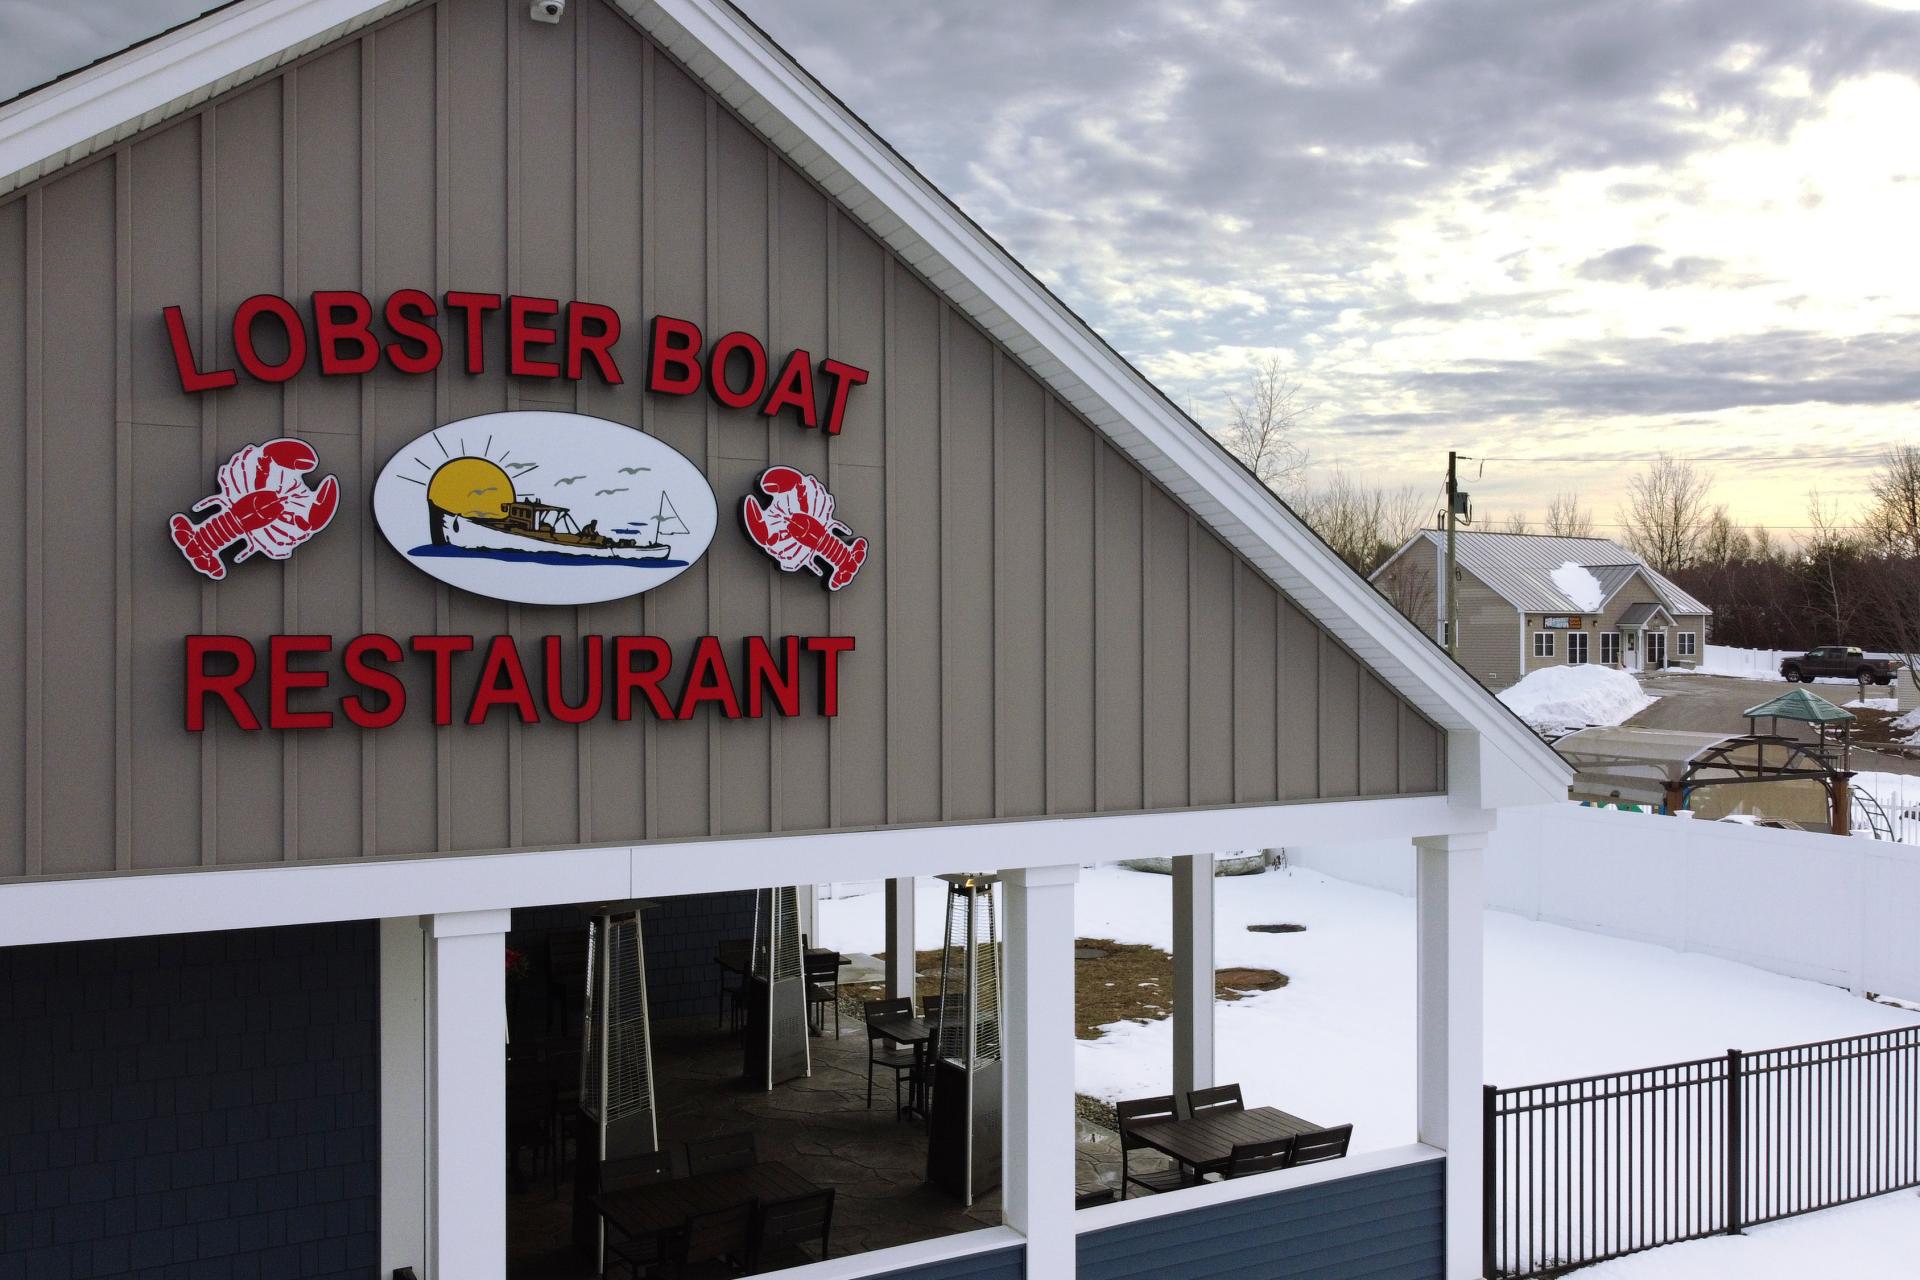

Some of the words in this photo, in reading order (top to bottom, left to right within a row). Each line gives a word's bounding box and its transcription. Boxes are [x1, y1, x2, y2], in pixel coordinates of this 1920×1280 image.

[163, 290, 622, 392] LOBSTER
[649, 316, 868, 434] BOAT
[185, 634, 856, 732] RESTAURANT
